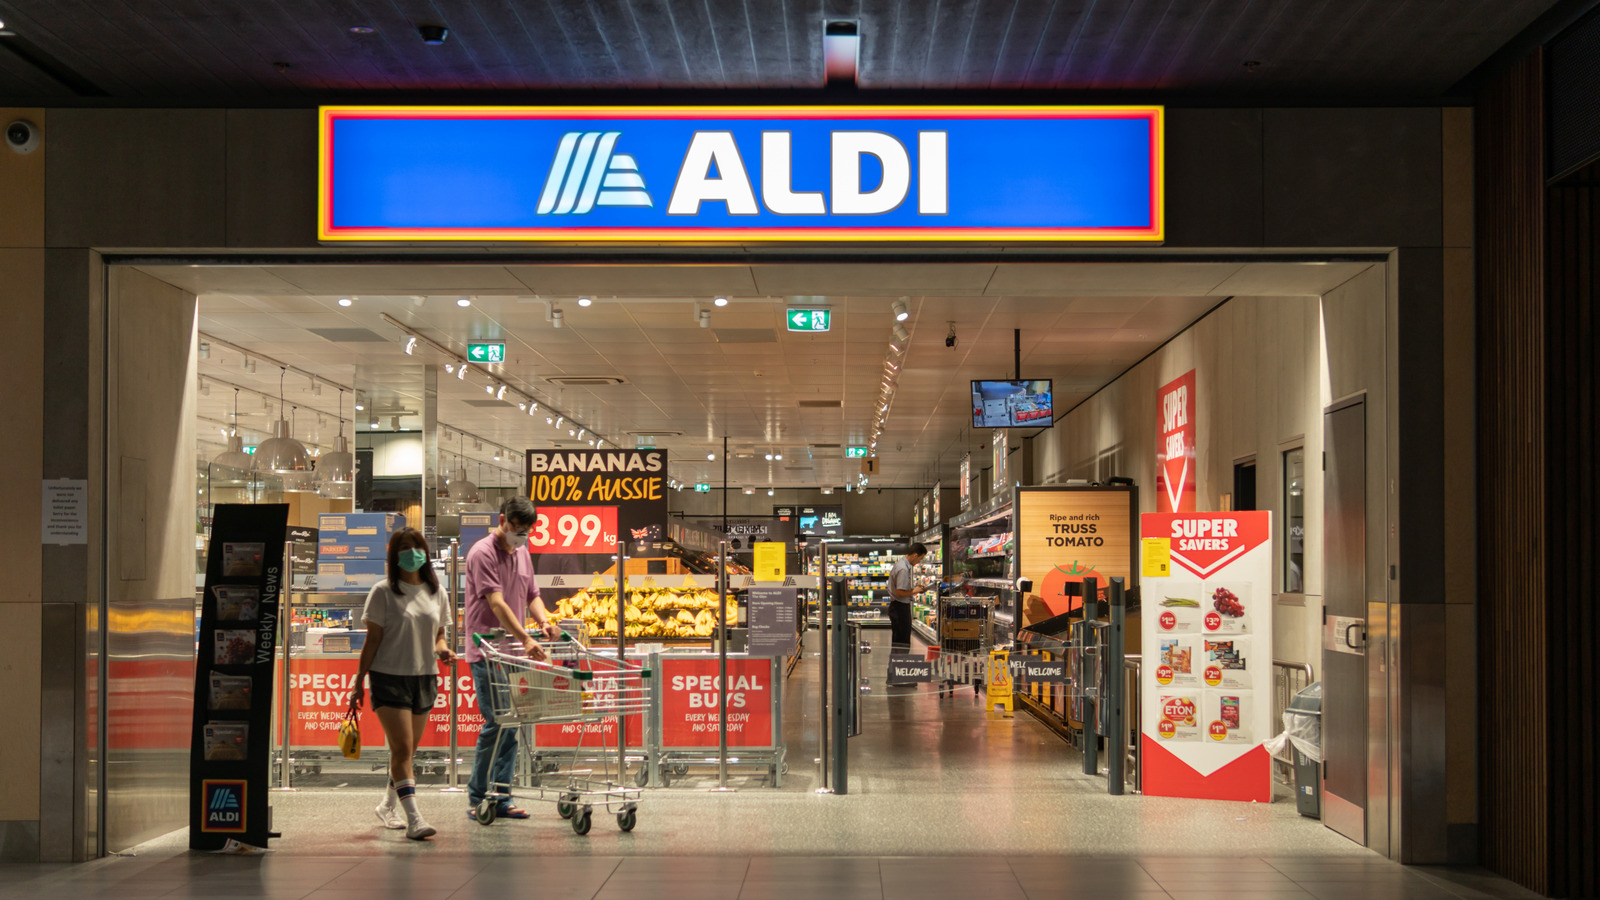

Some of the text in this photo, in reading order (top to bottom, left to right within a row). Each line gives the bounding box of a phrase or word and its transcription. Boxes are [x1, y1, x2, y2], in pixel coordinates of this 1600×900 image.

[667, 131, 949, 215] ALDI
[1163, 385, 1188, 434] SUPER
[1166, 431, 1185, 462] SAVERS
[531, 452, 662, 472] BANANAS
[867, 460, 873, 472] 1
[530, 475, 662, 501] 100% AUSSIE
[1050, 514, 1067, 522] Ripe
[529, 514, 616, 547] 3.99 kg
[1052, 524, 1097, 534] TRUSS
[1171, 519, 1238, 538] SUPER
[1046, 537, 1104, 547] TOMATO
[1179, 539, 1229, 551] SAVERS
[256, 566, 278, 664] Weekly News
[895, 666, 928, 676] WELCOME
[1028, 666, 1062, 676] WELCOME
[1165, 706, 1193, 715] ETON
[298, 712, 319, 720] EVERY
[429, 714, 450, 722] EVERY
[685, 712, 750, 722] EVERY WEESDAY
[305, 721, 342, 730] AND SATUR
[436, 724, 482, 732] AND ATURDA
[562, 724, 576, 733] AND
[692, 723, 744, 732] AND SATRDAY
[210, 812, 239, 822] ALDI
